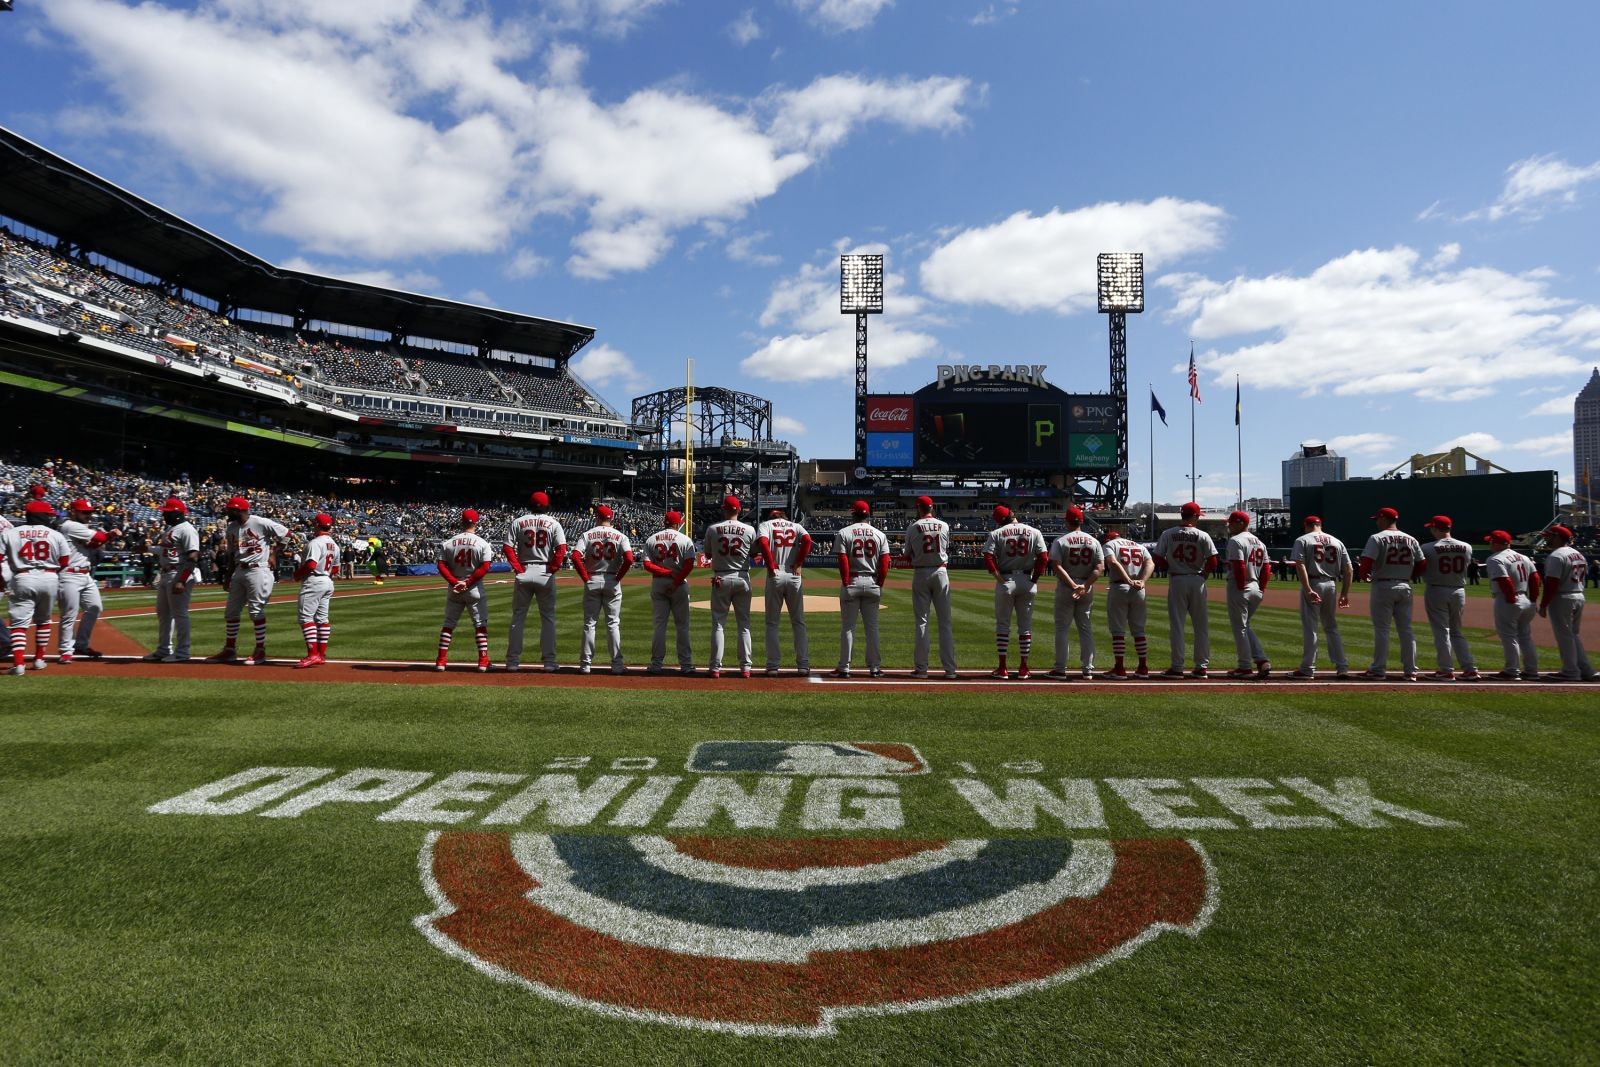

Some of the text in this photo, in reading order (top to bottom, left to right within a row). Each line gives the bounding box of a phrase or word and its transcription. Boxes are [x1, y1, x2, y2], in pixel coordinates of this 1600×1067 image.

[937, 365, 1049, 390] PNC PARK
[1086, 406, 1113, 417] PNC
[570, 436, 592, 444] KOPPERS
[519, 519, 553, 529] MARTINEZ
[716, 526, 746, 536] WIETERS
[772, 521, 794, 529] WACHA
[852, 529, 874, 537] REYES
[917, 523, 943, 533] MILLER
[1002, 528, 1031, 537] MIKOLAS
[19, 530, 49, 538] BADER
[452, 538, 477, 547] O'NEILL
[524, 530, 548, 548] 38
[588, 532, 621, 541] ROBINSON
[772, 529, 796, 547] 52
[1067, 536, 1092, 545] MAYERS
[18, 540, 50, 561] 48
[591, 541, 616, 561] 33
[655, 543, 678, 562] 34
[718, 537, 743, 556] 32
[852, 539, 877, 558] 29
[922, 534, 940, 554] 21
[1006, 538, 1029, 557] 39
[1172, 543, 1197, 563] 43
[324, 553, 334, 571] 6
[455, 549, 472, 567] 41
[1068, 547, 1093, 566] 59
[1119, 547, 1143, 567] 55
[1248, 547, 1264, 566] 49
[1313, 544, 1337, 564] 53
[1386, 547, 1411, 565] 22
[1438, 555, 1466, 574] 60
[1517, 563, 1527, 582] 11
[1572, 563, 1586, 583] 37
[146, 766, 1467, 830] OPENING WEEK
